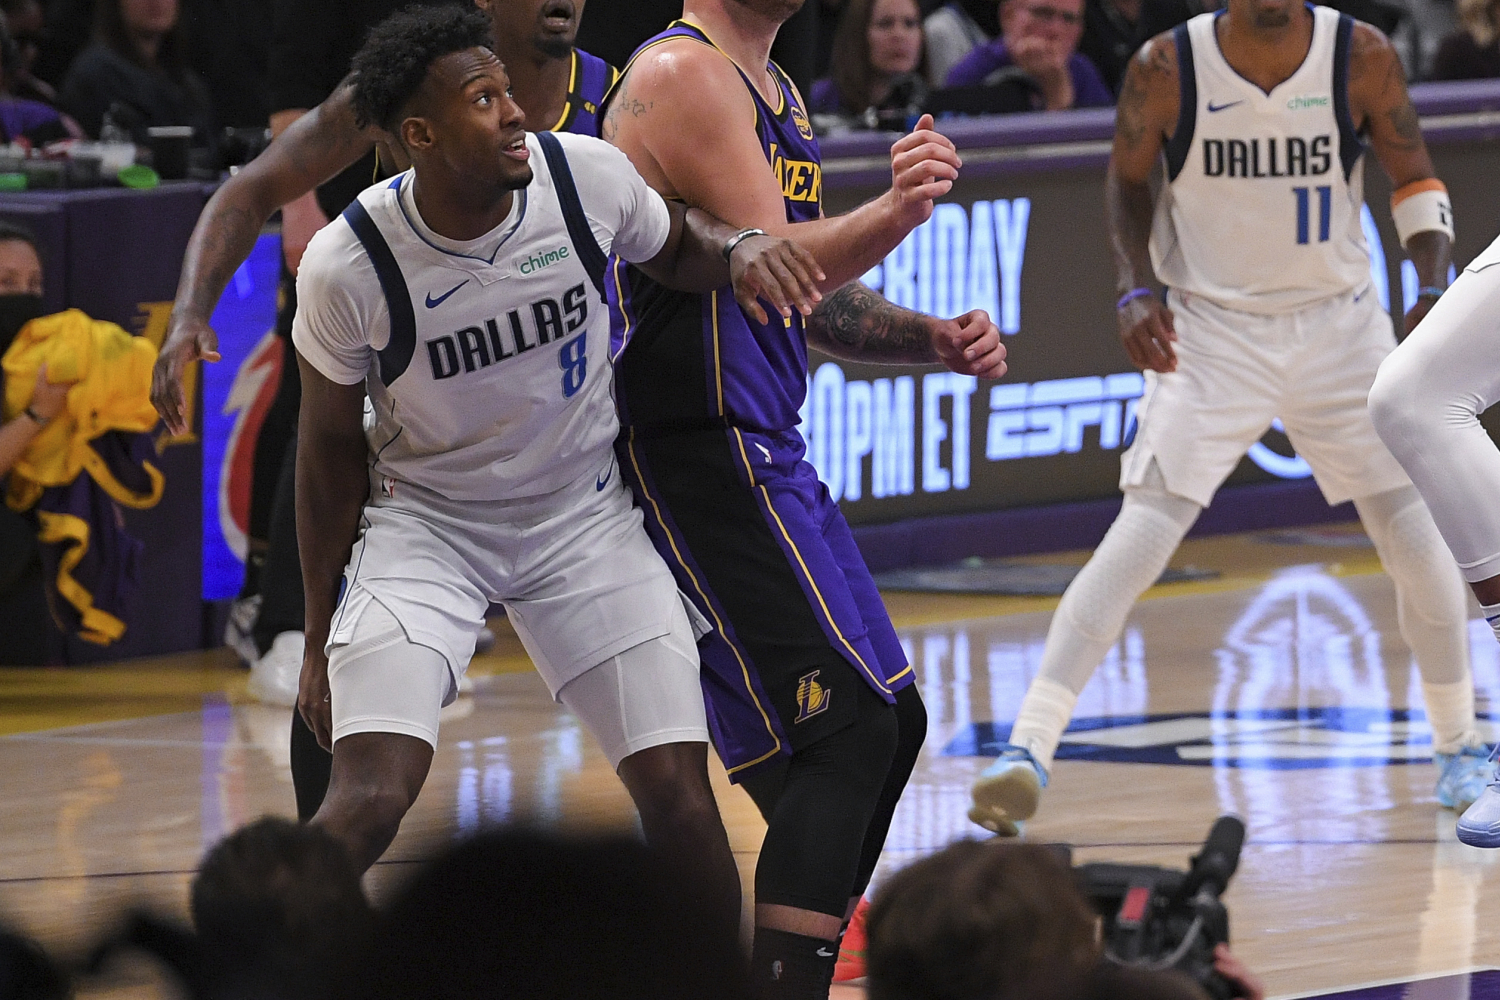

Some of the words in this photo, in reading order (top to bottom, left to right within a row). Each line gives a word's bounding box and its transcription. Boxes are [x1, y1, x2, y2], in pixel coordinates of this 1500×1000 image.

[1203, 136, 1331, 178] DALLAS
[1292, 185, 1331, 245] 11
[520, 246, 570, 275] chime
[424, 280, 588, 381] DALLAS
[558, 329, 588, 400] 8
[922, 371, 978, 492] ET
